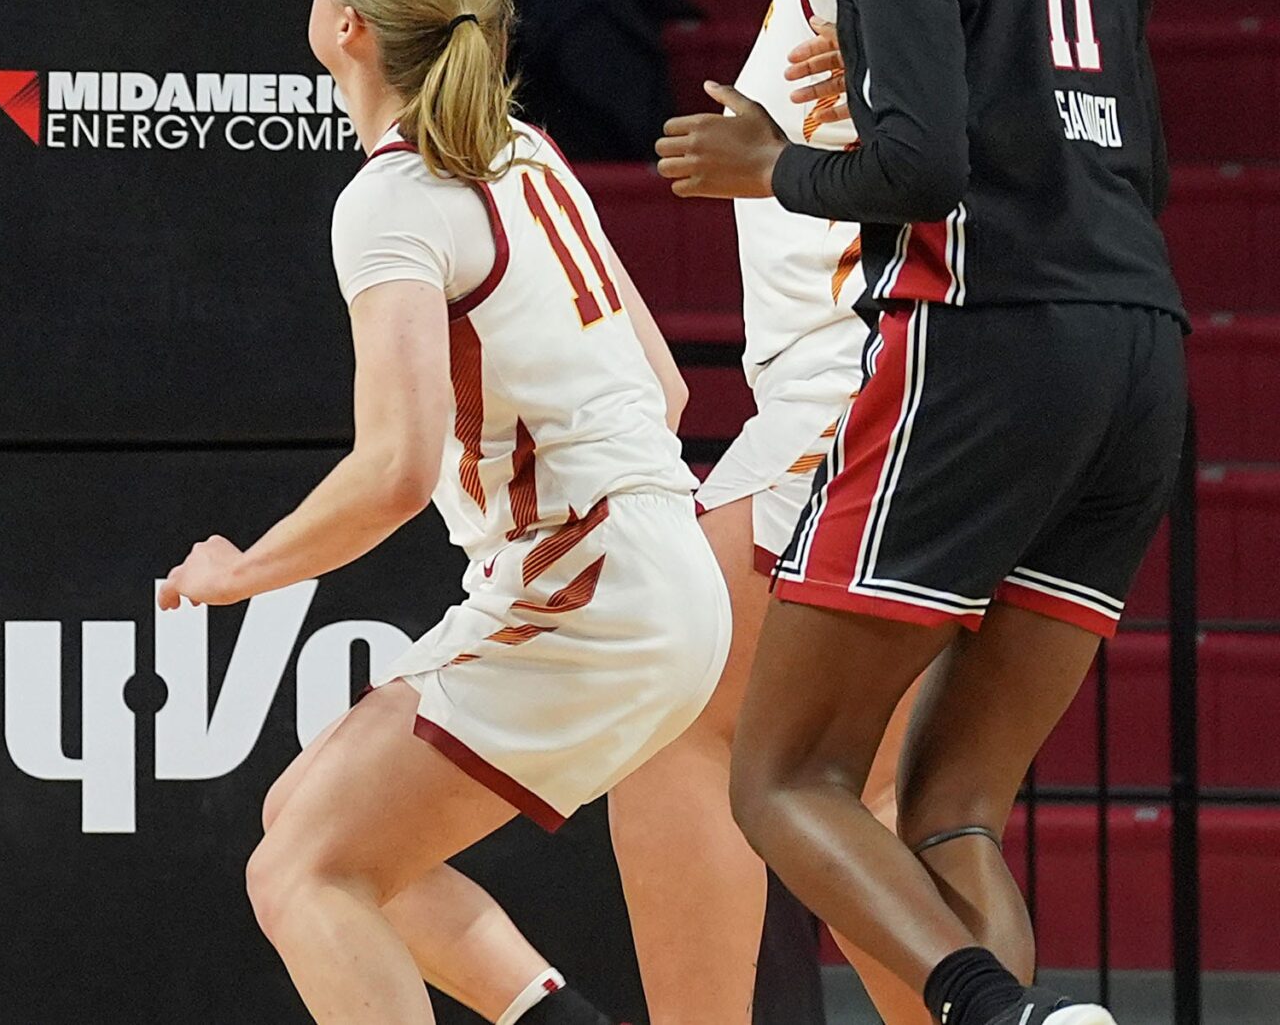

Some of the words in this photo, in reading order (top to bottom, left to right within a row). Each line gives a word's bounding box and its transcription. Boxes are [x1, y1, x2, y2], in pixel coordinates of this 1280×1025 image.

[47, 115, 214, 150] ENERGY
[224, 115, 362, 151] COMP
[521, 164, 623, 331] 11
